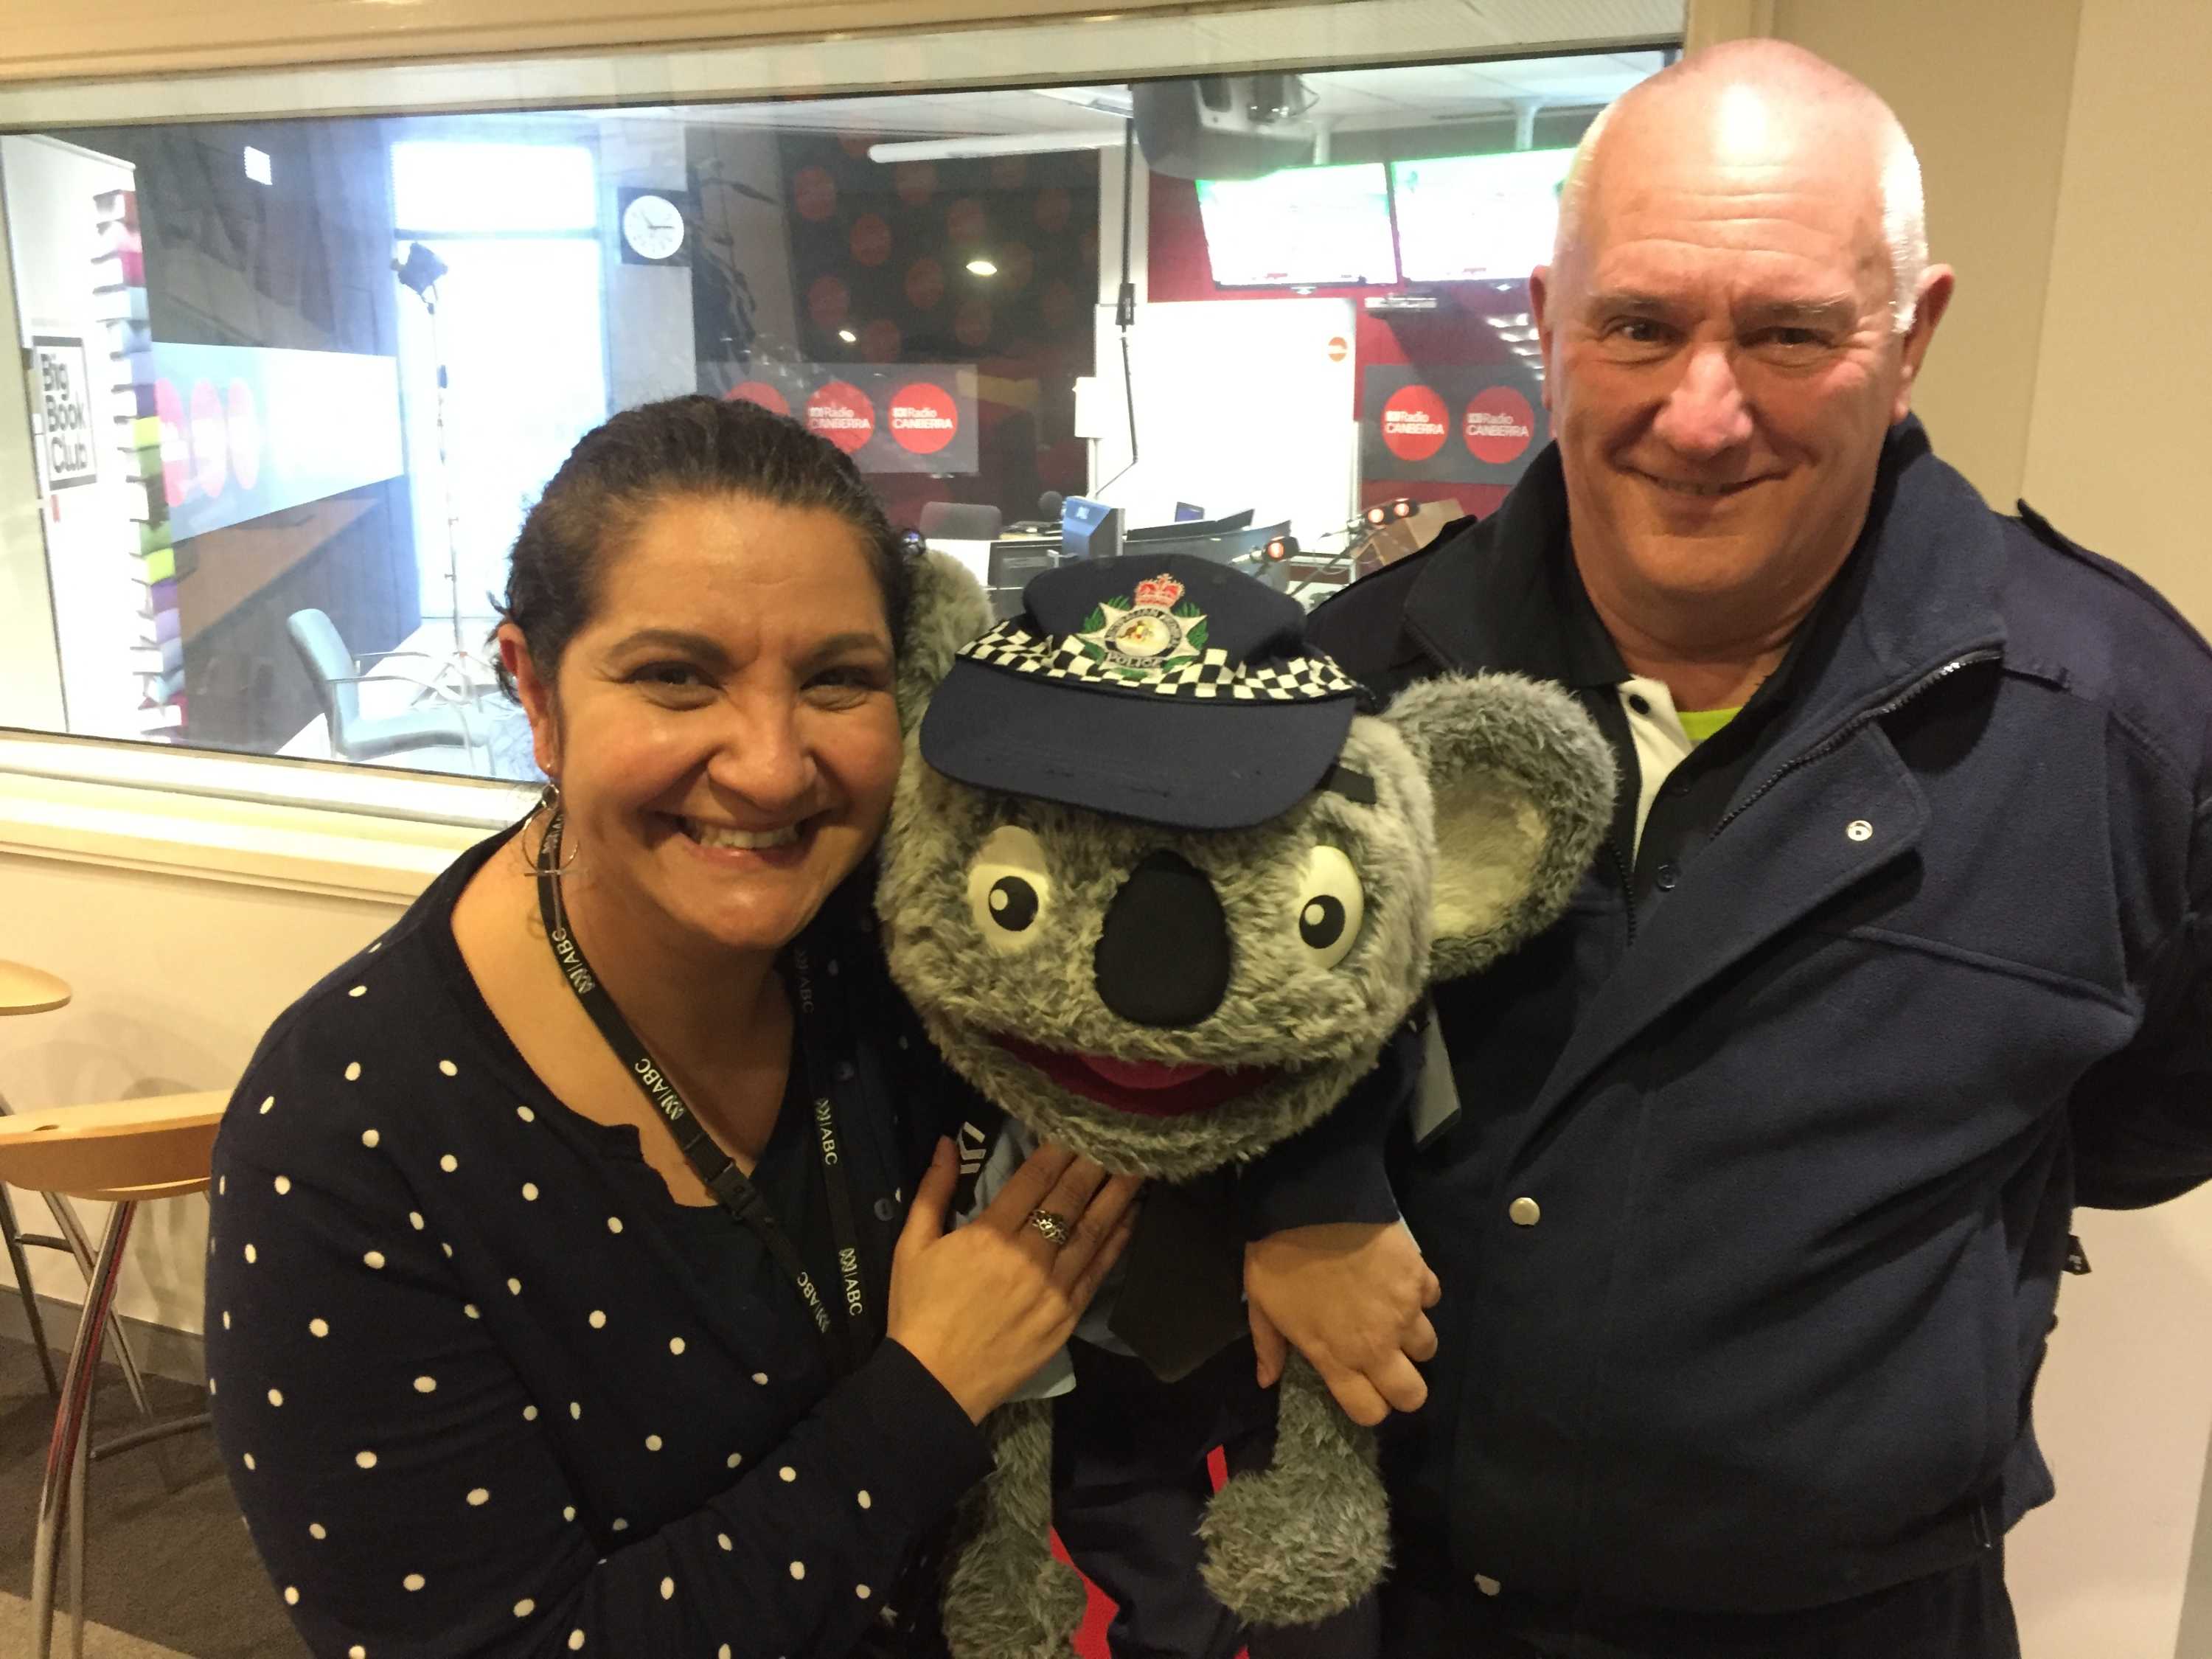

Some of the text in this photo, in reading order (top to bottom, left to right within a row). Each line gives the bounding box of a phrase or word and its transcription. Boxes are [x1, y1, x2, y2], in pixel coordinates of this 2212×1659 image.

[41, 354, 69, 401] Big
[46, 392, 86, 432] Book
[811, 418, 872, 429] CANBERRA
[824, 406, 854, 418] Radio
[892, 418, 953, 429] CANBERRA
[908, 407, 937, 418] Radio
[1400, 411, 1429, 422] Radio
[1482, 412, 1514, 425] Radio
[1385, 422, 1444, 435] CANBERRA
[1466, 424, 1530, 437] CANBERRA
[52, 435, 88, 473] Club
[1106, 651, 1162, 669] POLICE
[552, 927, 581, 963] ABC
[799, 977, 815, 1015] ABC
[635, 1058, 669, 1093] ABC
[820, 1127, 838, 1165] ABC
[797, 1271, 821, 1307] ABC
[844, 1279, 863, 1316] ABC
